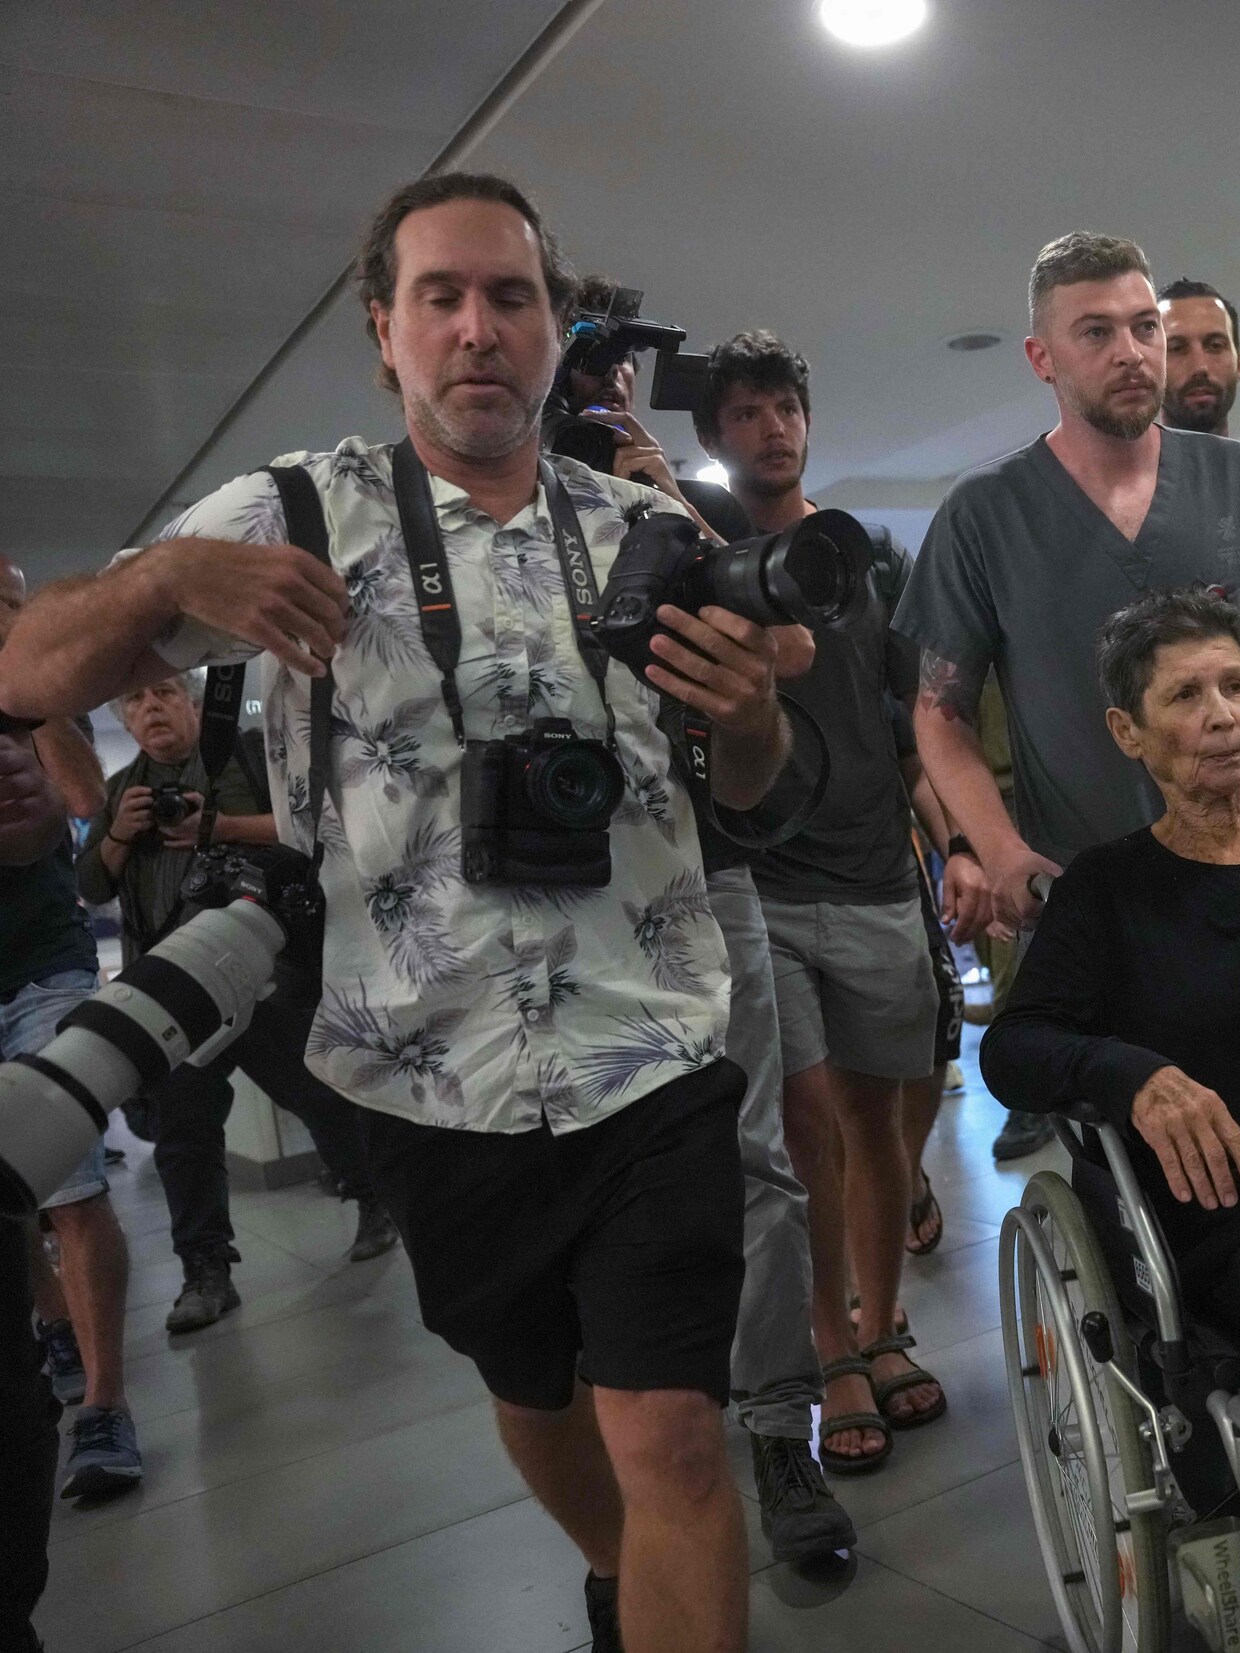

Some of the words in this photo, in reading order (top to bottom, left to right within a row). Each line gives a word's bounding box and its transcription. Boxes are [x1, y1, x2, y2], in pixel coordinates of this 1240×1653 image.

[562, 528, 594, 606] SONY
[543, 732, 573, 740] SONY
[239, 880, 264, 895] SONY
[1213, 1538, 1240, 1647] WheelShare
